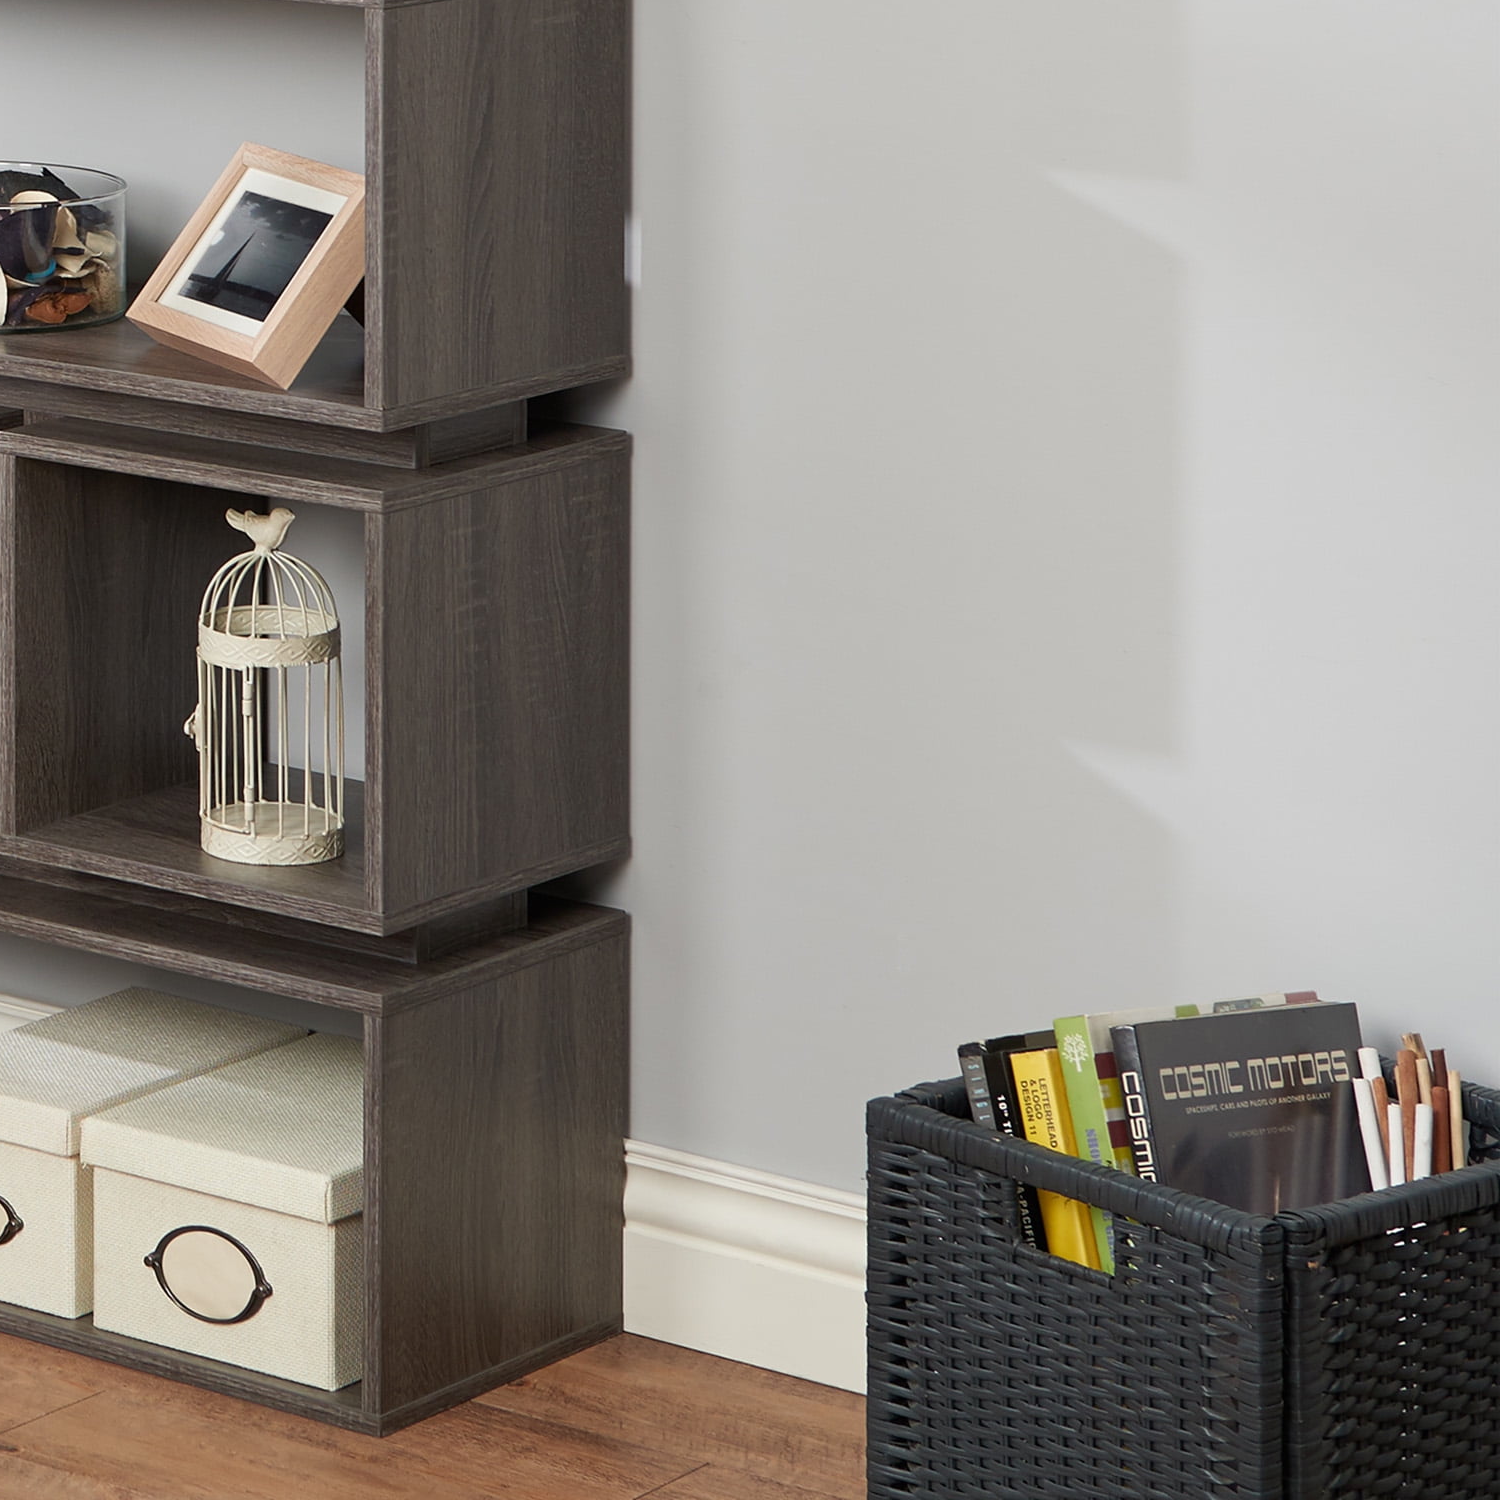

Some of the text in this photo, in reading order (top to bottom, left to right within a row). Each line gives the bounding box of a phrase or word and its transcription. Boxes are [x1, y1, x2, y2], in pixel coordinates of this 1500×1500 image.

[1159, 1050, 1350, 1100] COSMIC MOTORS
[1021, 1080, 1035, 1122] DESIGN
[1032, 1089, 1043, 1120] LOGO
[1038, 1078, 1058, 1148] LETTERHEAD
[1220, 1103, 1235, 1111] CARS
[1236, 1100, 1248, 1108] AND
[1269, 1096, 1278, 1105] OF
[1279, 1094, 1305, 1104] ANOTHER
[1307, 1092, 1331, 1101] GALAXY
